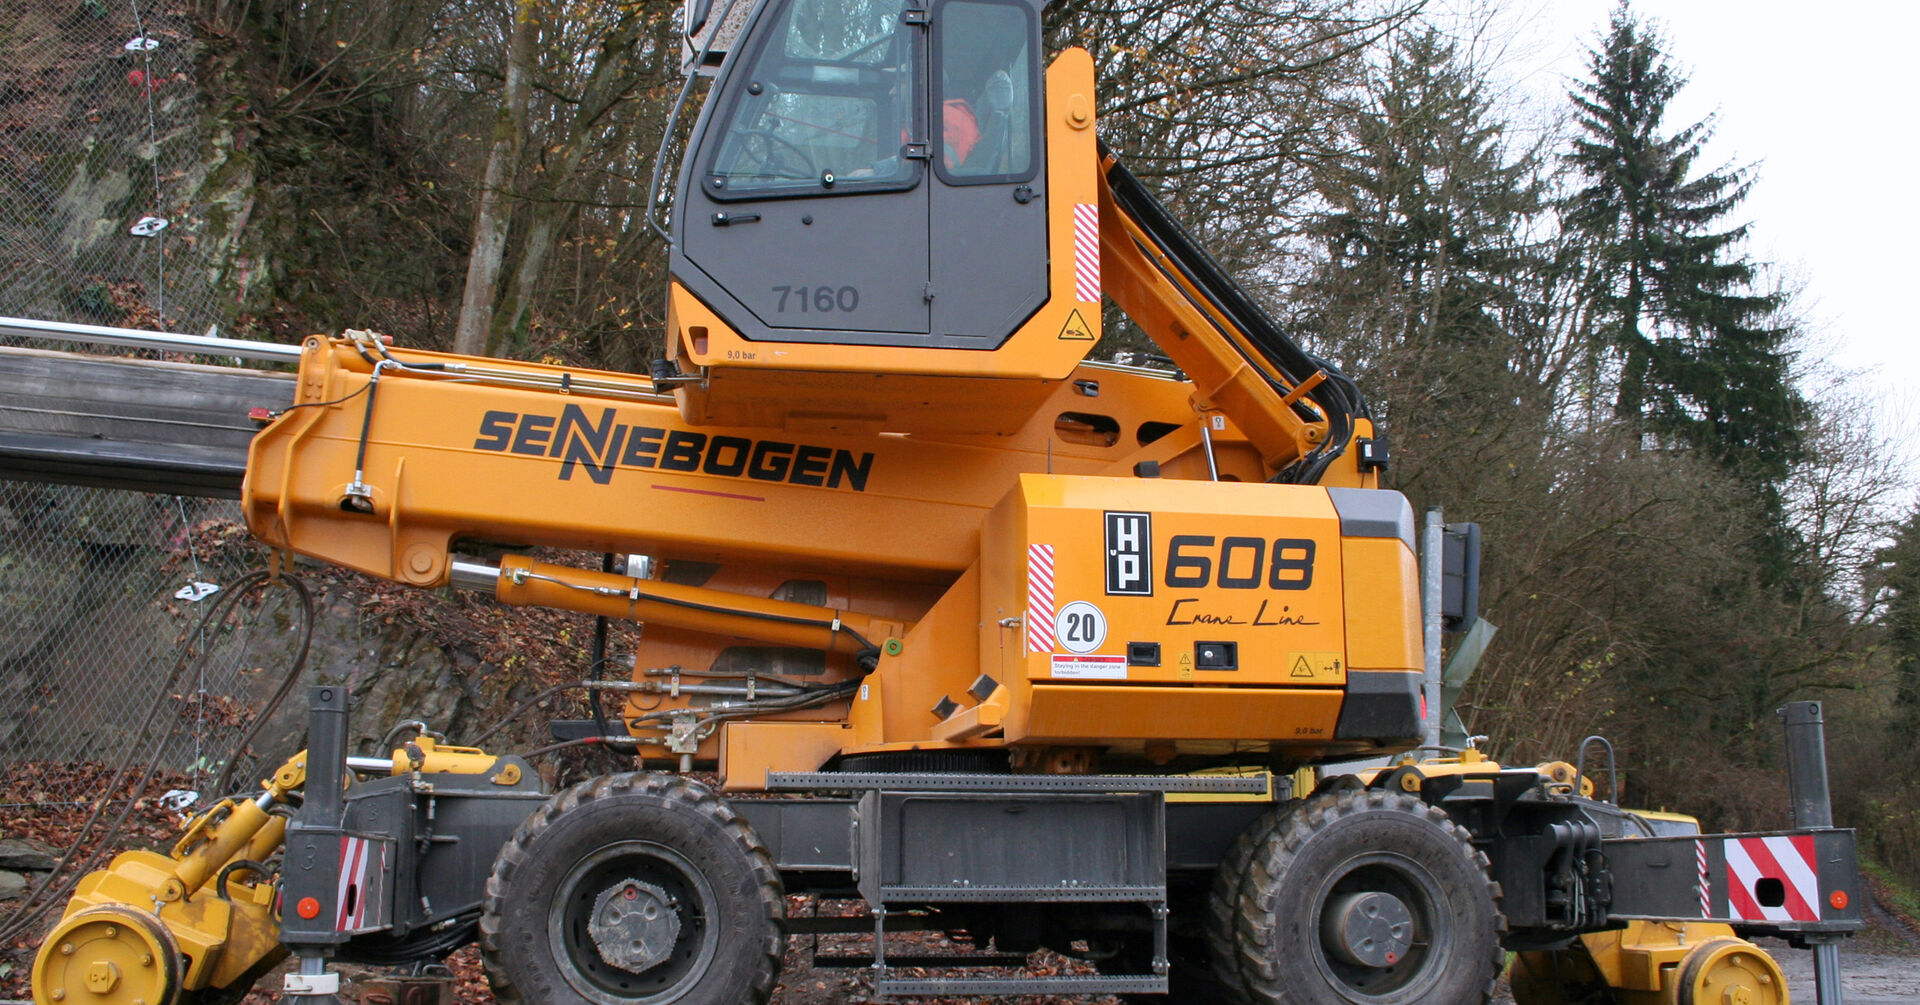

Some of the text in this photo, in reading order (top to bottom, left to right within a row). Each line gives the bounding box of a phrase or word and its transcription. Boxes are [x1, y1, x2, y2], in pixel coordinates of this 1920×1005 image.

[771, 285, 860, 313] 7160
[727, 350, 756, 360] 9,0 bar
[473, 403, 875, 492] SENNEBOGEN
[1164, 534, 1317, 591] 608
[1166, 598, 1320, 626] Crane Line
[1067, 612, 1096, 643] 20
[301, 844, 318, 871] 3
